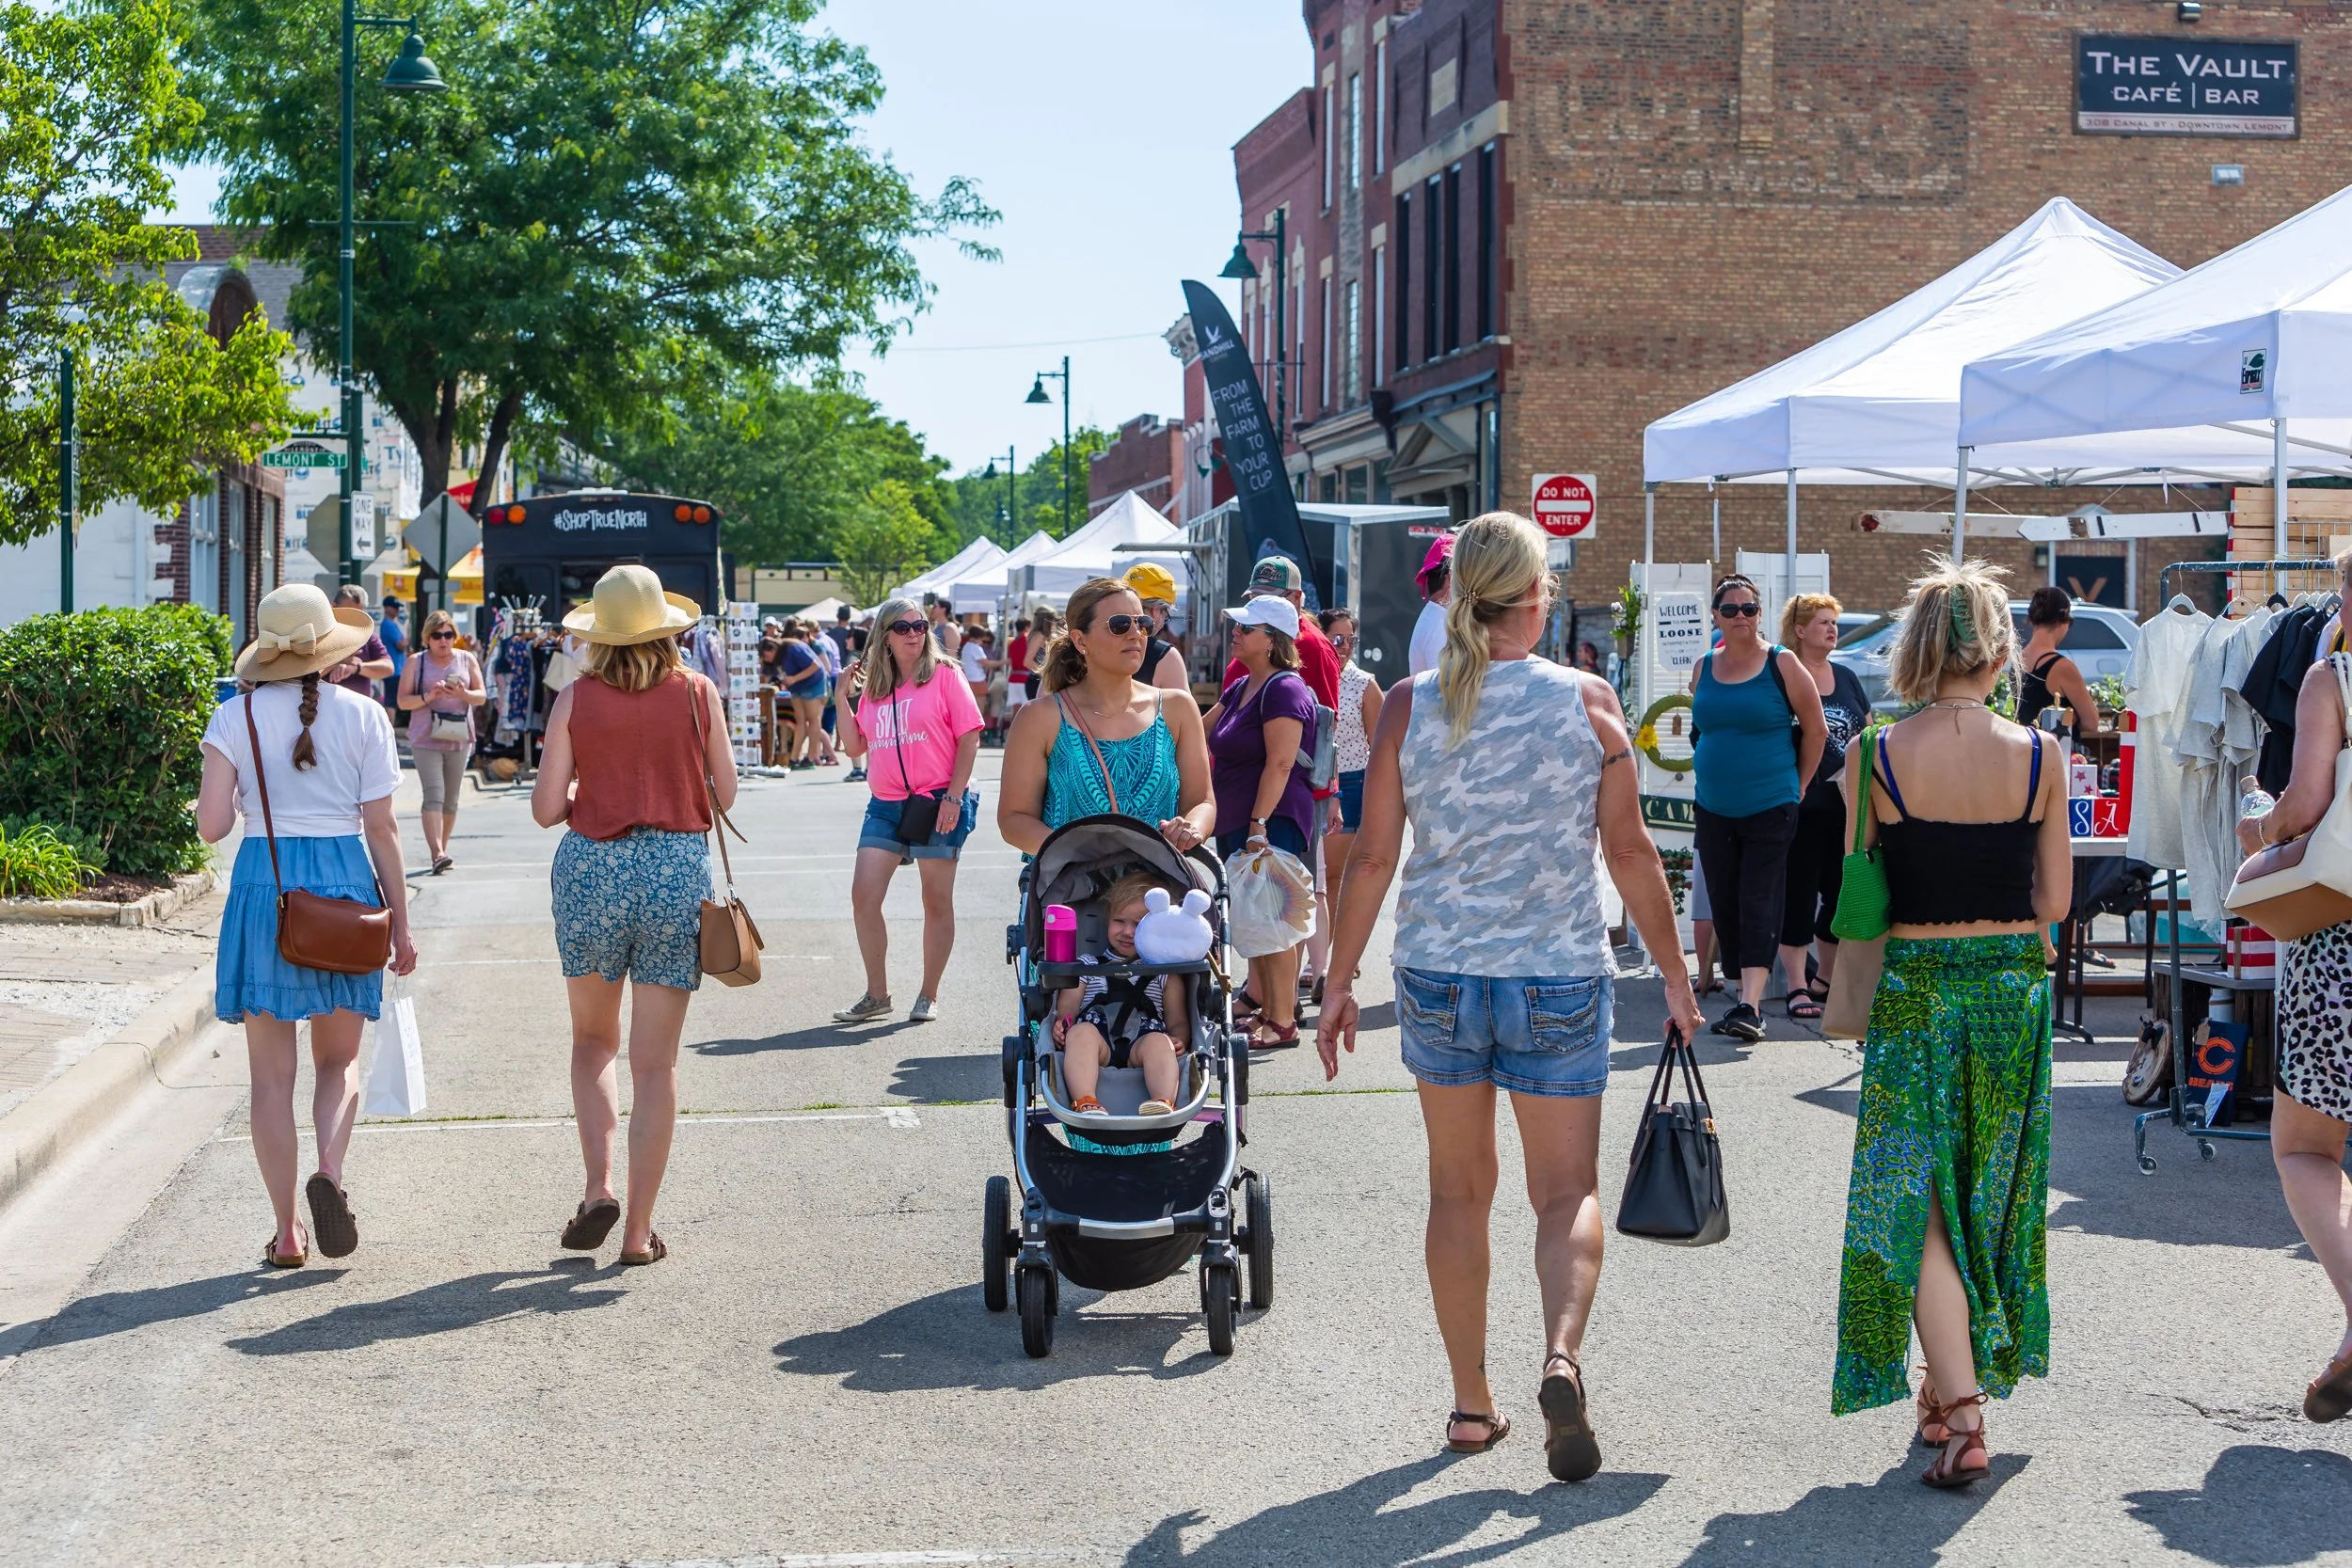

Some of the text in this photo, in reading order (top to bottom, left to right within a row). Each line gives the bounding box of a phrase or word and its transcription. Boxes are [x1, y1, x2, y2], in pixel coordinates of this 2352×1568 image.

[2087, 52, 2287, 78] THE VAULT
[2113, 82, 2260, 104] CAFÉ BAR
[2114, 119, 2149, 128] CANAL
[2179, 121, 2240, 130] DOWNTOWN
[1212, 379, 1249, 404] FROM
[1230, 397, 1255, 417] THE
[1225, 416, 1261, 440] FARM
[1247, 434, 1264, 451] TO
[266, 453, 346, 466] LEMONT ST
[1235, 451, 1269, 475] YOUR
[1249, 470, 1273, 490] CUP
[1542, 486, 1586, 498] DO NOT
[355, 499, 372, 514] ONE
[355, 518, 372, 531] WAY
[1546, 515, 1581, 525] ENTER
[1659, 604, 1698, 617] WELCOME
[1659, 628, 1702, 638] LOOSE
